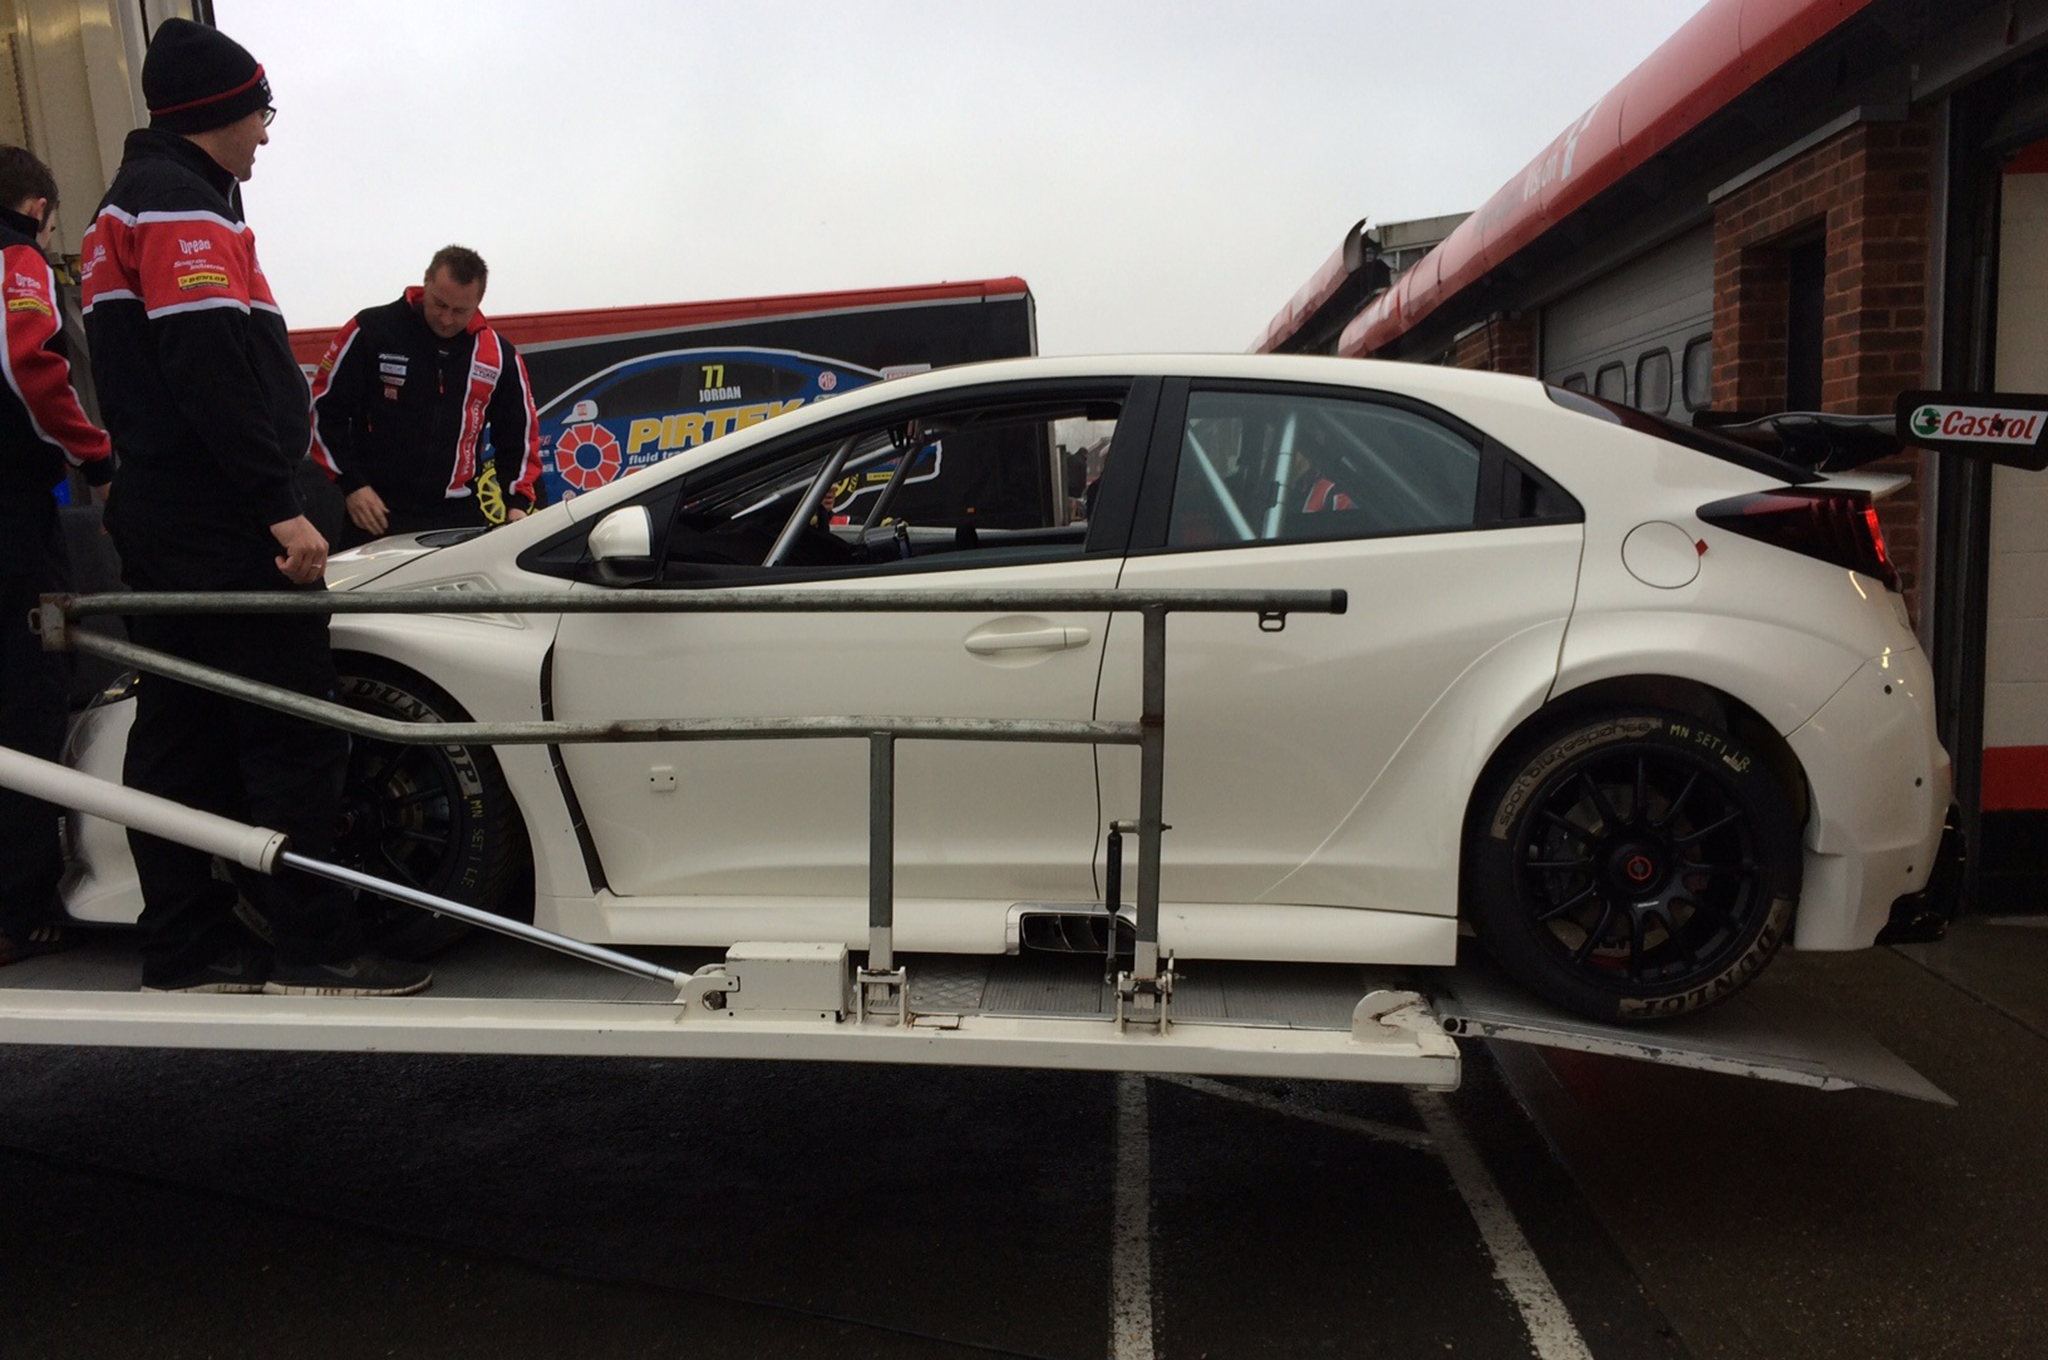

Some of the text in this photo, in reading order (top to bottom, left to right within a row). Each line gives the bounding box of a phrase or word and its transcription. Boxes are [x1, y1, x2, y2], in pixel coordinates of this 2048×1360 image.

[701, 364, 725, 389] 77
[699, 386, 742, 402] JORDAN
[1942, 409, 2038, 440] Castrol
[628, 450, 658, 465] fluid
[352, 679, 479, 785] DUNOP
[1669, 724, 1690, 738] MN
[1695, 730, 1721, 750] SET
[470, 799, 484, 818] MN
[1500, 775, 1531, 827] sport
